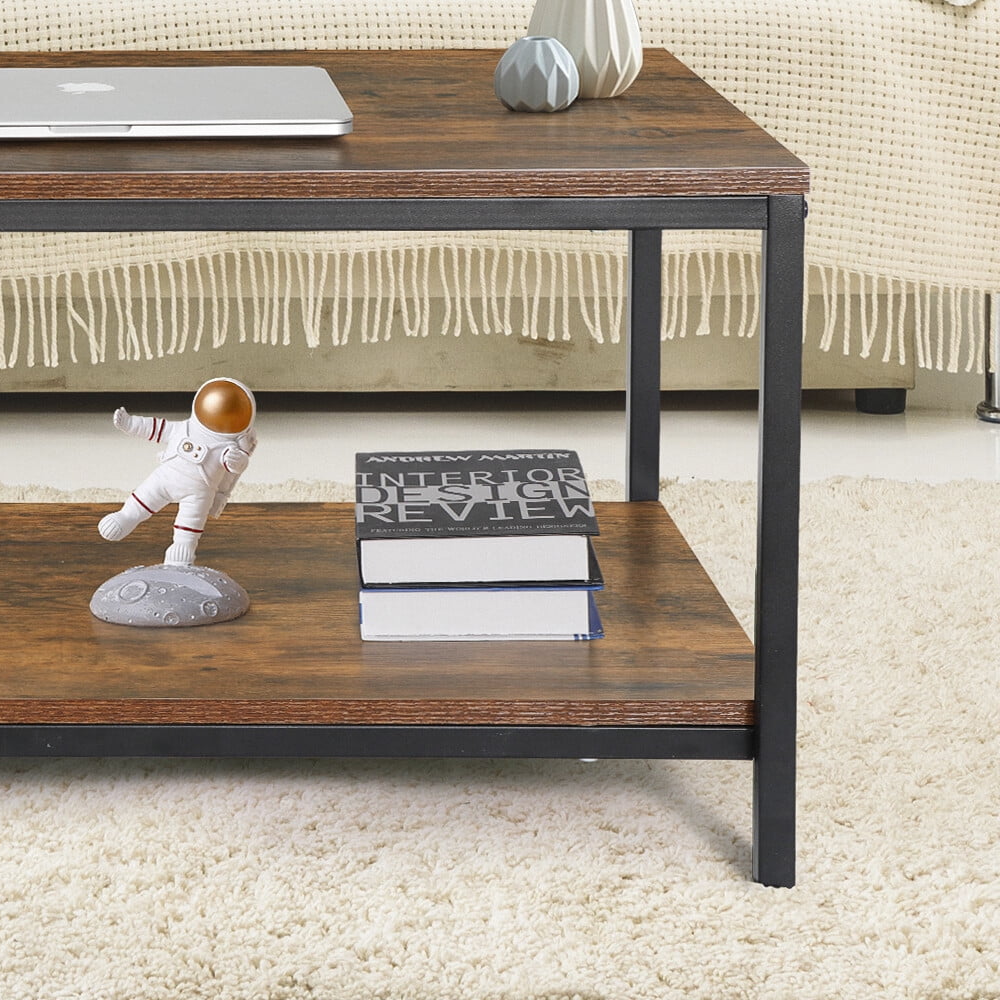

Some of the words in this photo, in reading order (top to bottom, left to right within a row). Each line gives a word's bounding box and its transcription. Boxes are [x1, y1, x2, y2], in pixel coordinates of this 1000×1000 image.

[356, 467, 585, 487] INTERIOR
[356, 480, 591, 505] DESIGN
[356, 498, 594, 523] REVIEW
